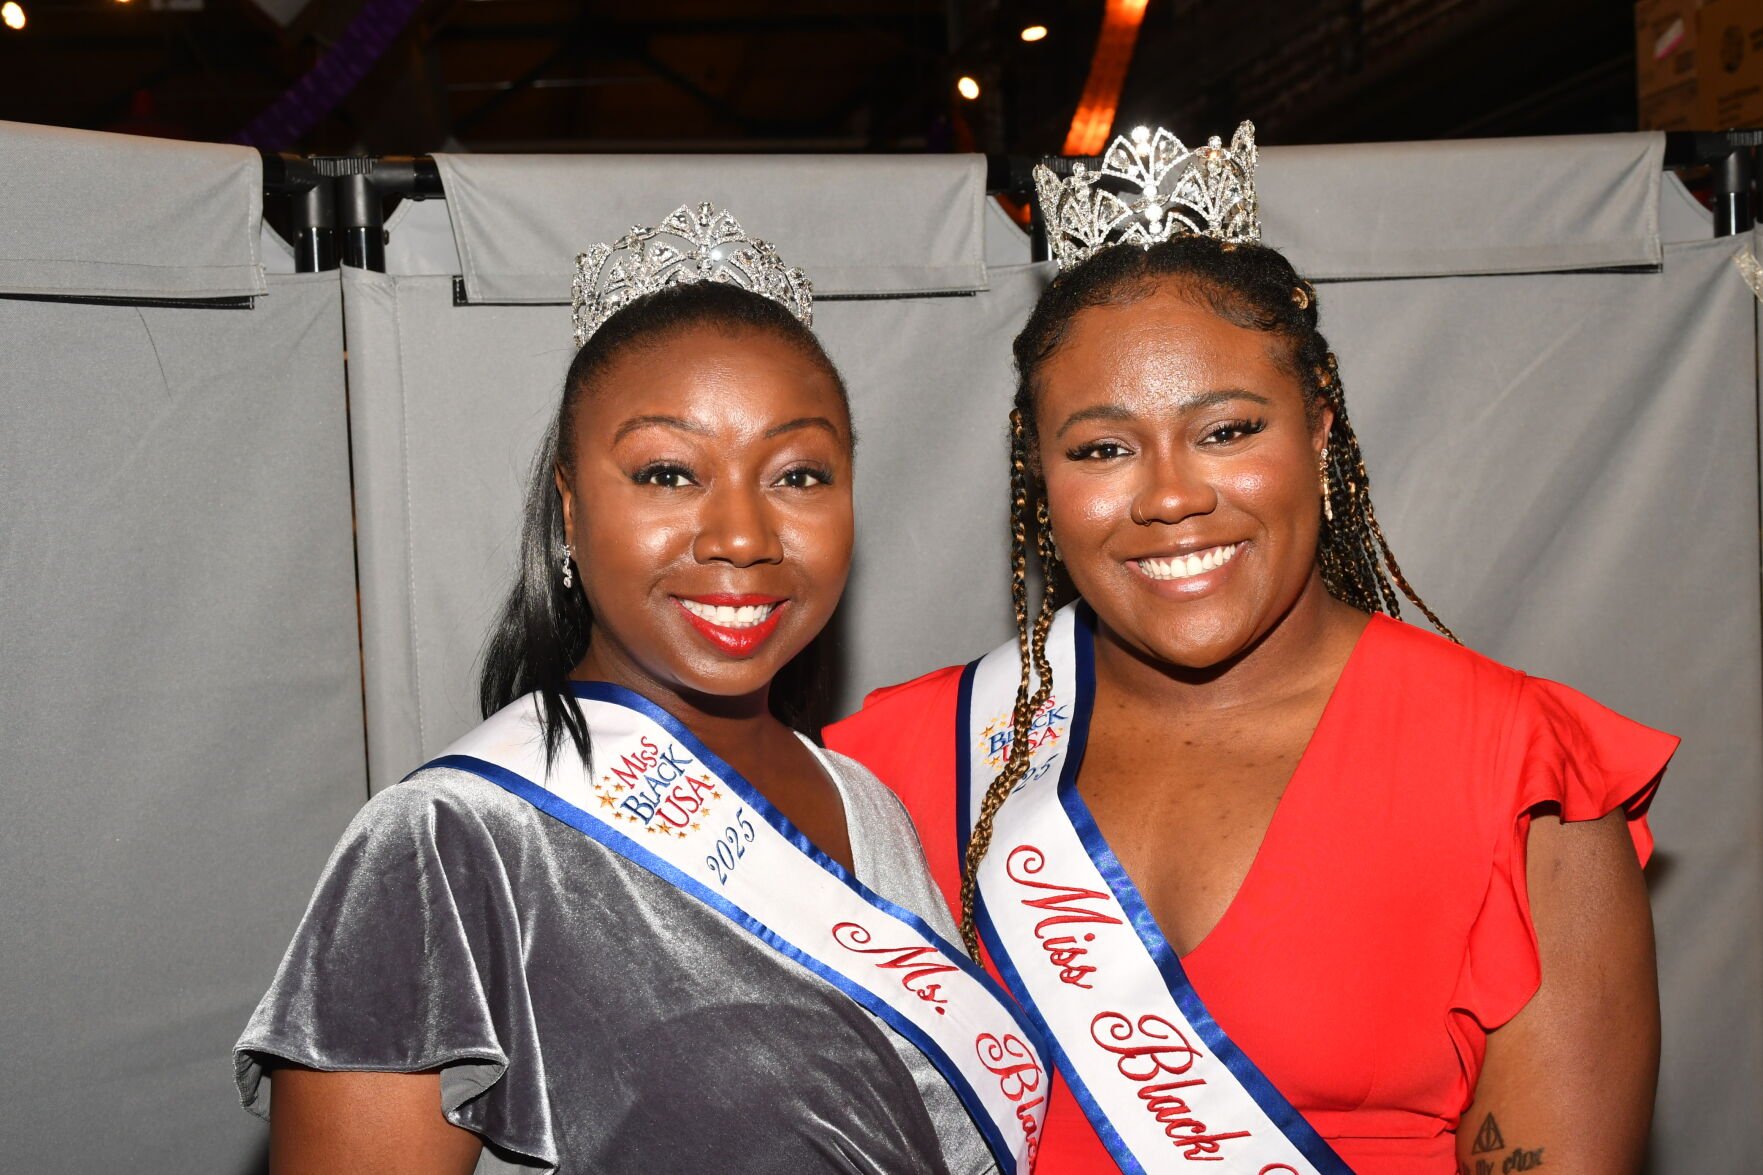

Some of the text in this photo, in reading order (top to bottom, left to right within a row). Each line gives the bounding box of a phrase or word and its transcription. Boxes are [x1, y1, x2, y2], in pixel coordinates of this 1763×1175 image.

[988, 704, 1068, 757] BLCK
[620, 743, 693, 825] BLACK
[655, 775, 715, 828] USA
[706, 807, 755, 886] 2025
[1006, 844, 1252, 1161] Miss Black
[831, 921, 1044, 1168] Ms. Blac
